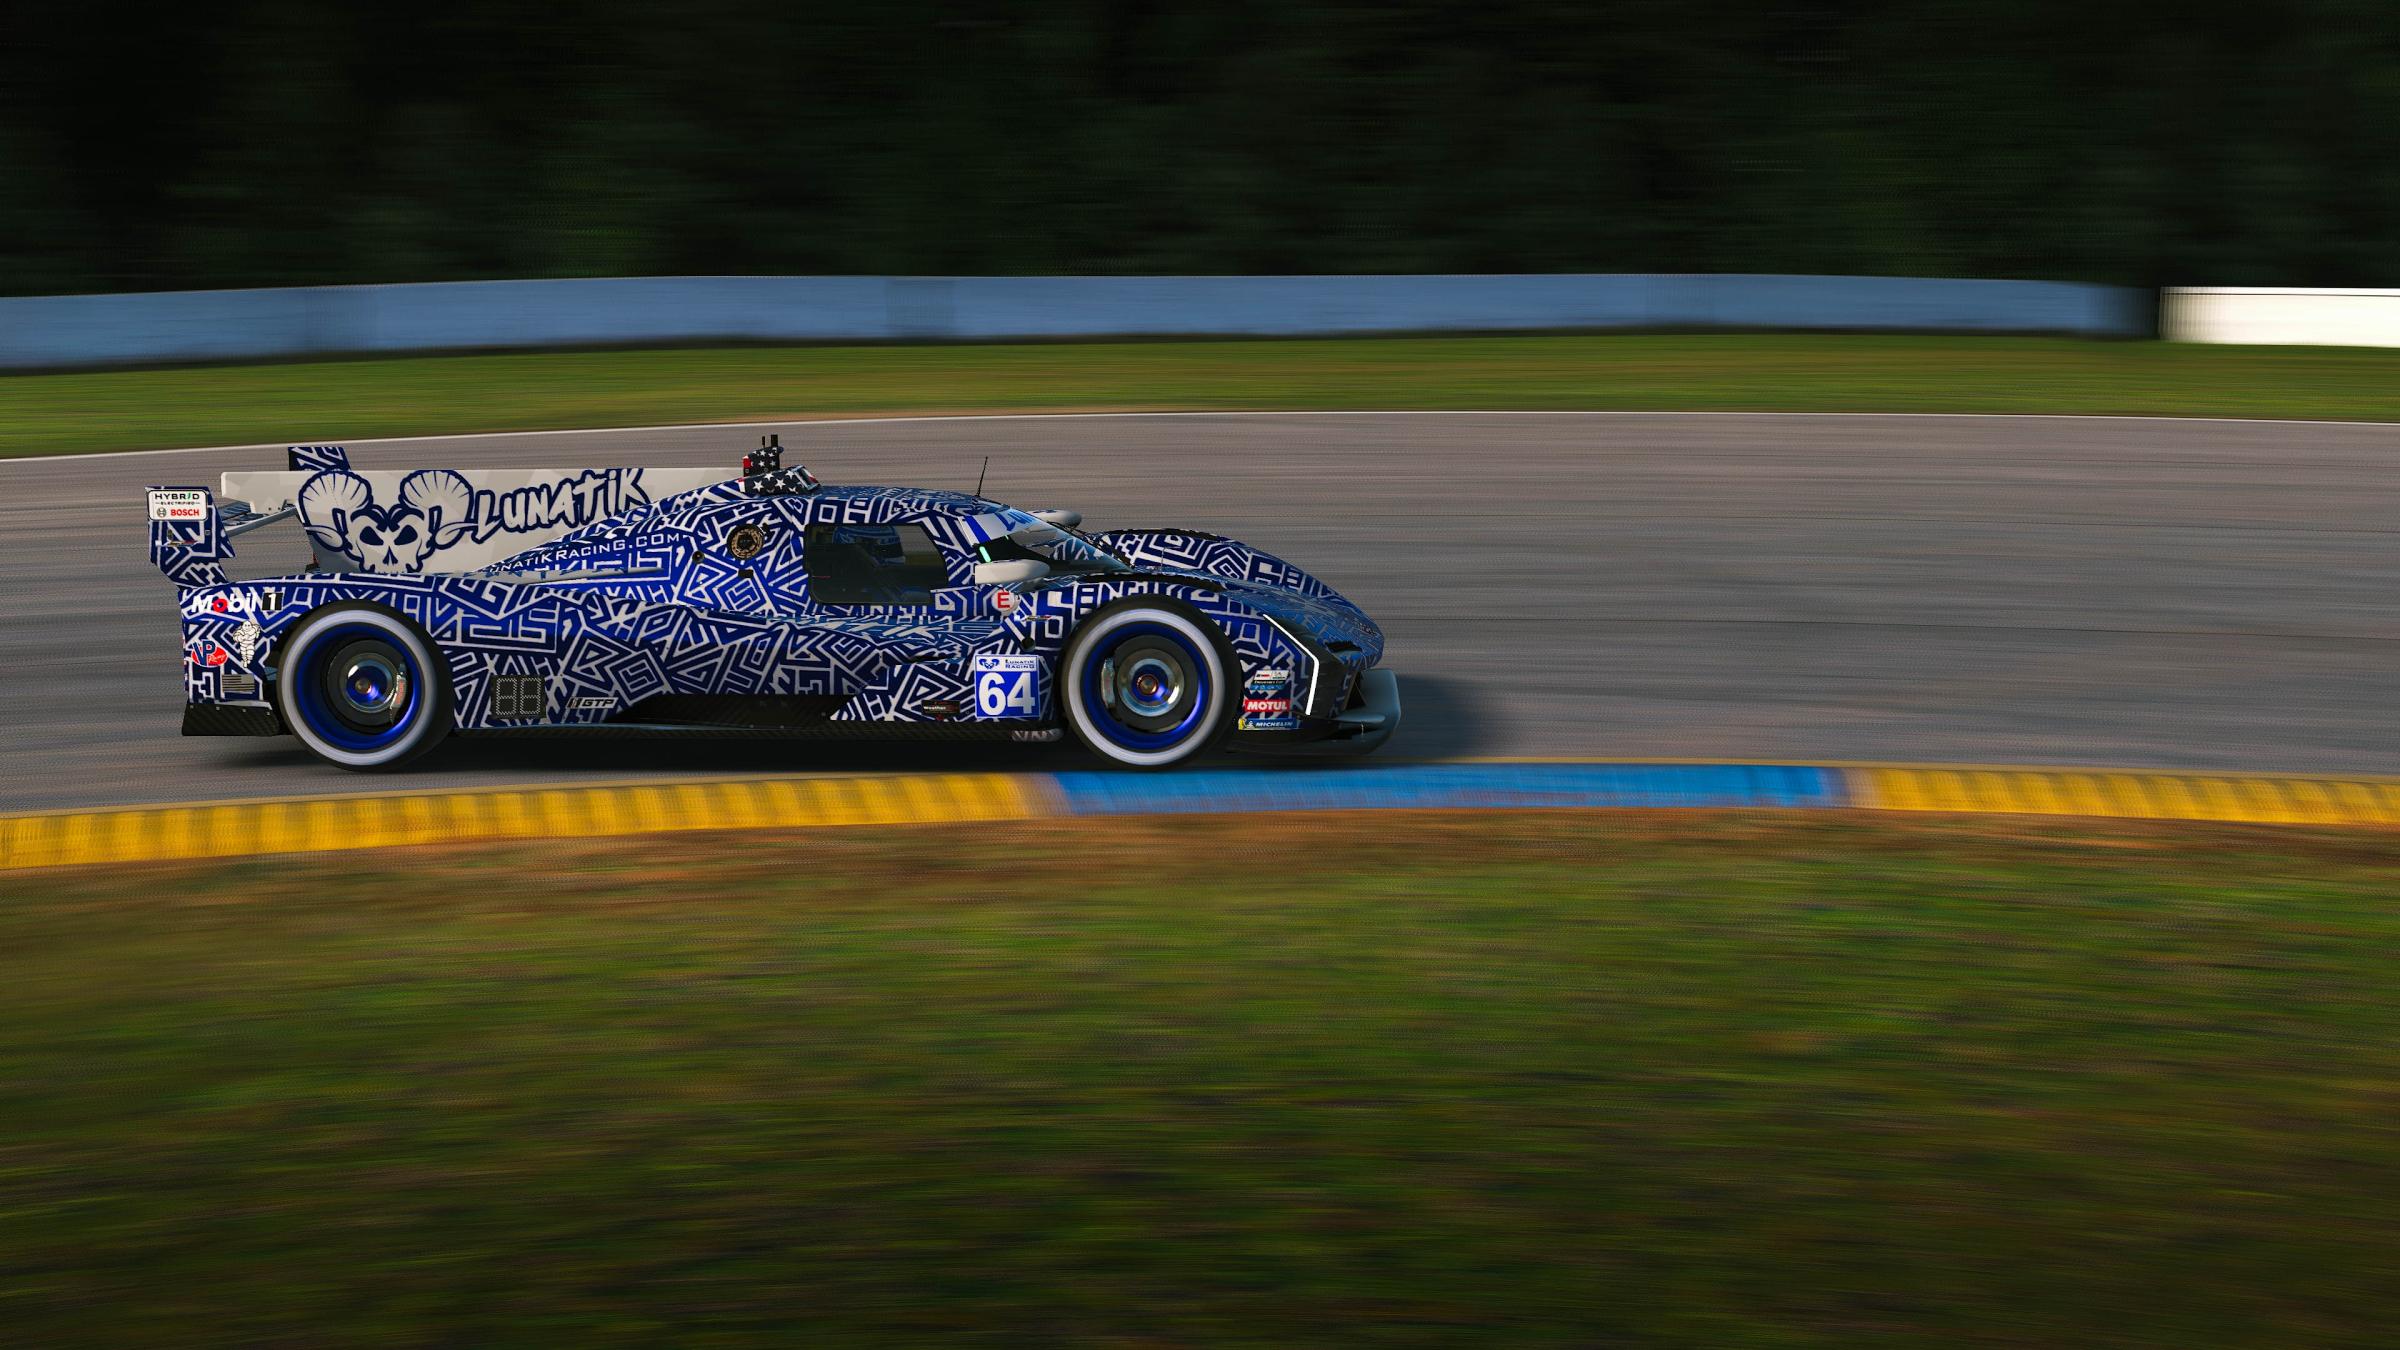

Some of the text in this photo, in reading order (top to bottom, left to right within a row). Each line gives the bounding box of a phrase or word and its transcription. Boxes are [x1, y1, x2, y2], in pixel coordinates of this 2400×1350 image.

[170, 508, 200, 517] BOSCH
[490, 533, 680, 573] UNATIKRACING.COM
[997, 591, 1010, 609] E
[979, 672, 1036, 716] 64
[582, 699, 615, 707] GTP
[1247, 701, 1288, 710] MOTUL
